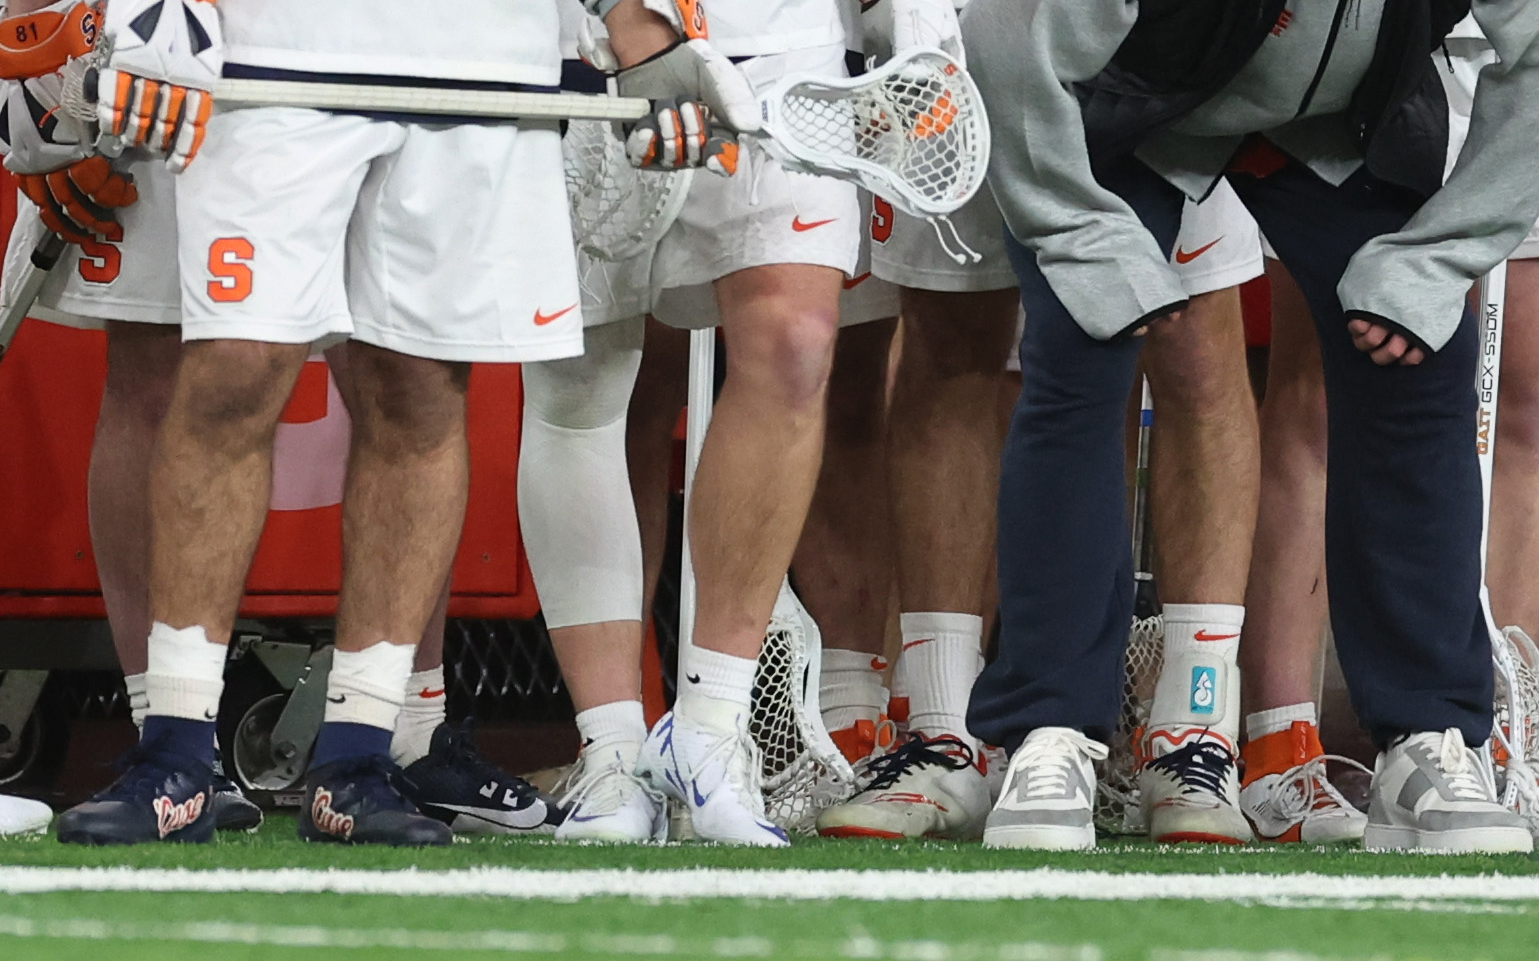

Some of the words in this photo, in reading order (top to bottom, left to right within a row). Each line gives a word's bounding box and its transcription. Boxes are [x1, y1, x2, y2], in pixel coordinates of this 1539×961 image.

[16, 21, 39, 43] 81
[80, 11, 97, 47] S
[207, 237, 255, 303] S
